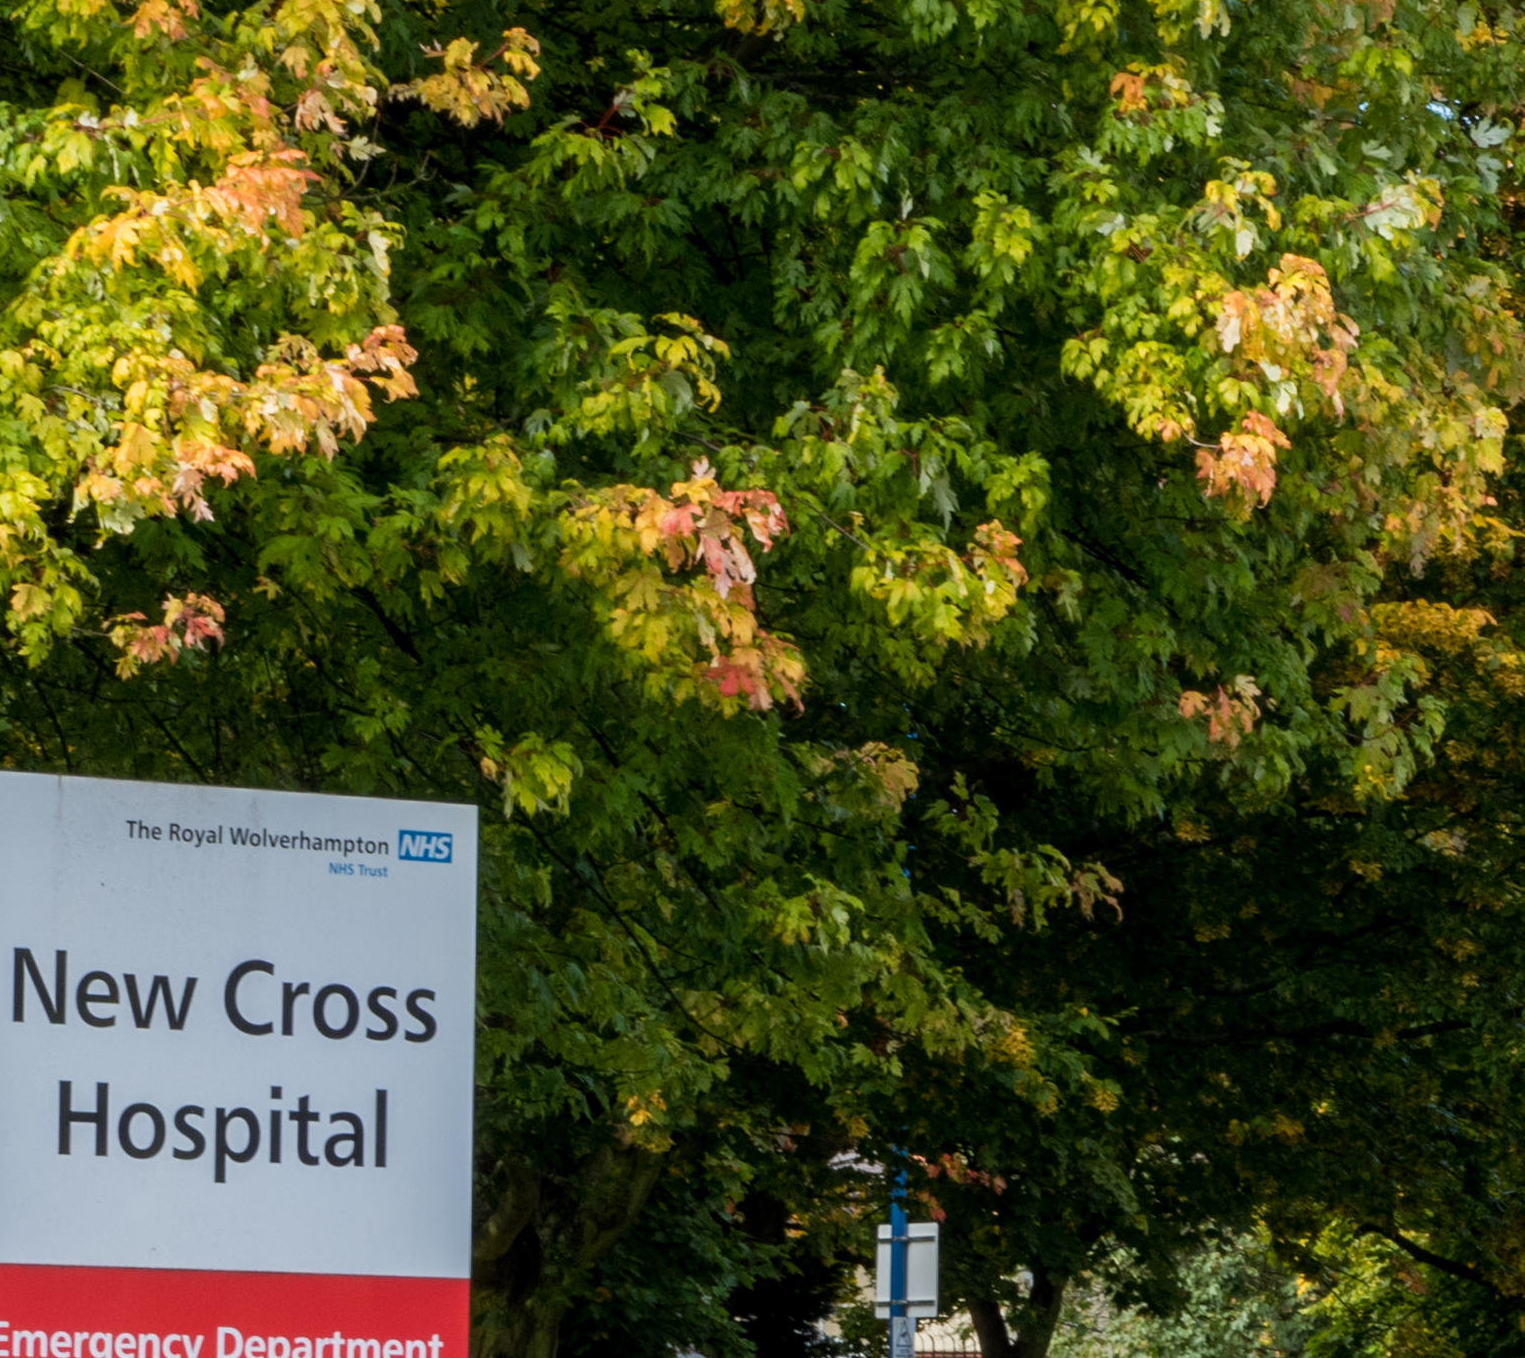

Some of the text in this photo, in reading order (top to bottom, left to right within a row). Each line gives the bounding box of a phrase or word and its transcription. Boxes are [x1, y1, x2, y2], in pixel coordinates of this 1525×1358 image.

[126, 820, 390, 857] The Royal Wolverhampton
[400, 832, 452, 861] NHS
[329, 862, 388, 878] NHS Trust
[11, 946, 438, 1044] New Cross
[57, 1079, 389, 1184] Hospital
